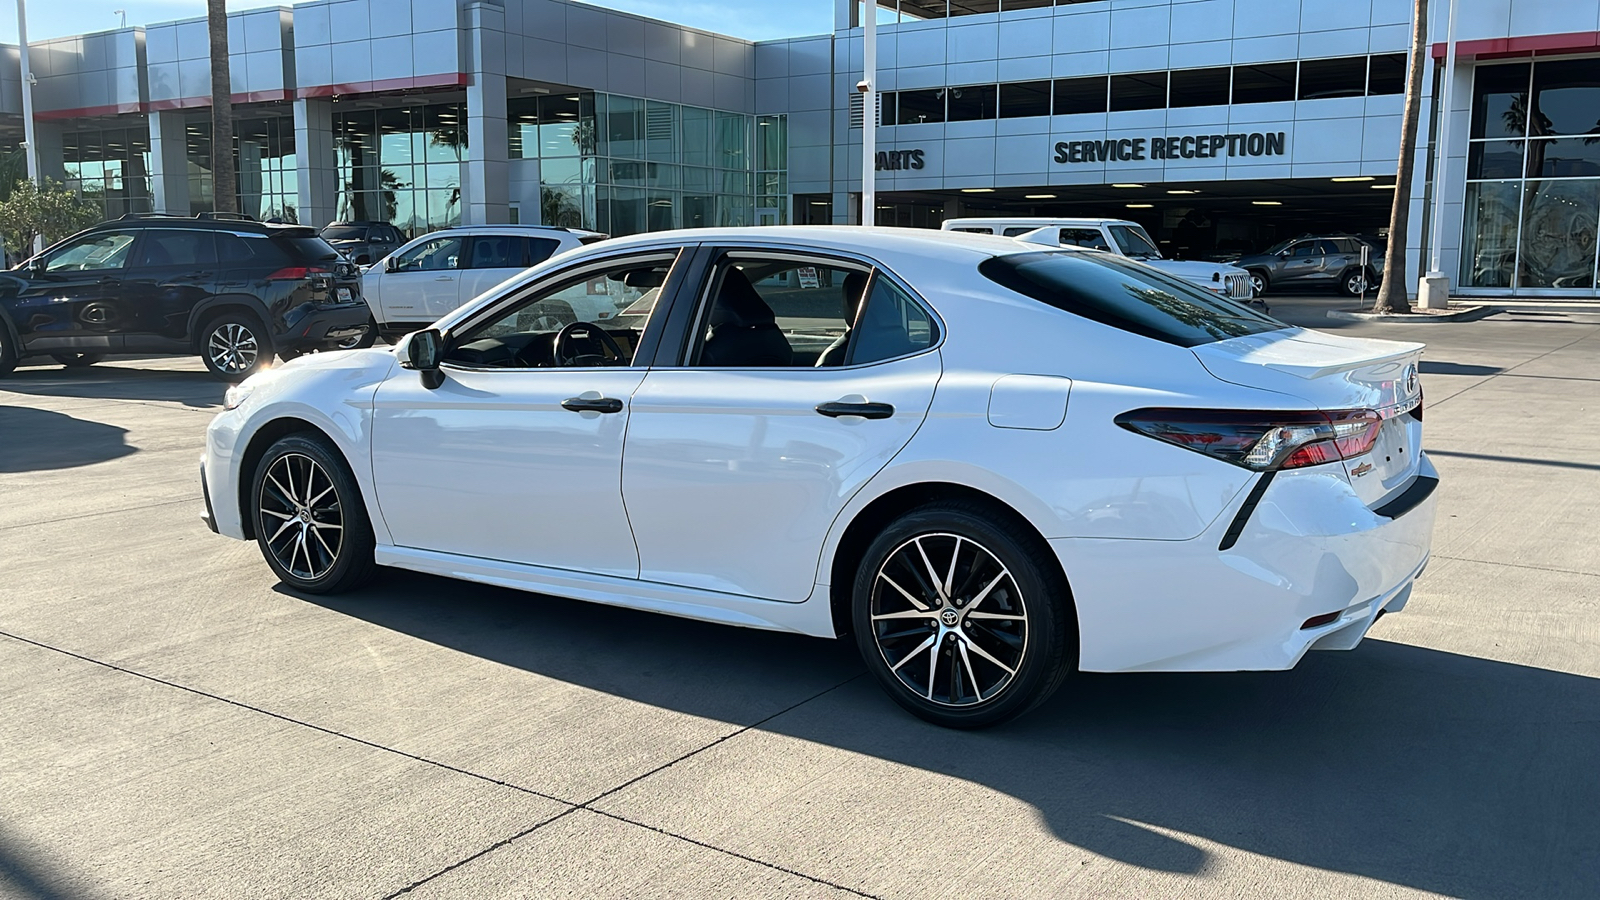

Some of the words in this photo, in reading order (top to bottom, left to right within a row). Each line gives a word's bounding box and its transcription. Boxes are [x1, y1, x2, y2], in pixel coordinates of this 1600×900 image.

[875, 149, 925, 171] ARTS
[1053, 138, 1146, 164] SERVICE
[1150, 132, 1285, 160] RECEPTION
